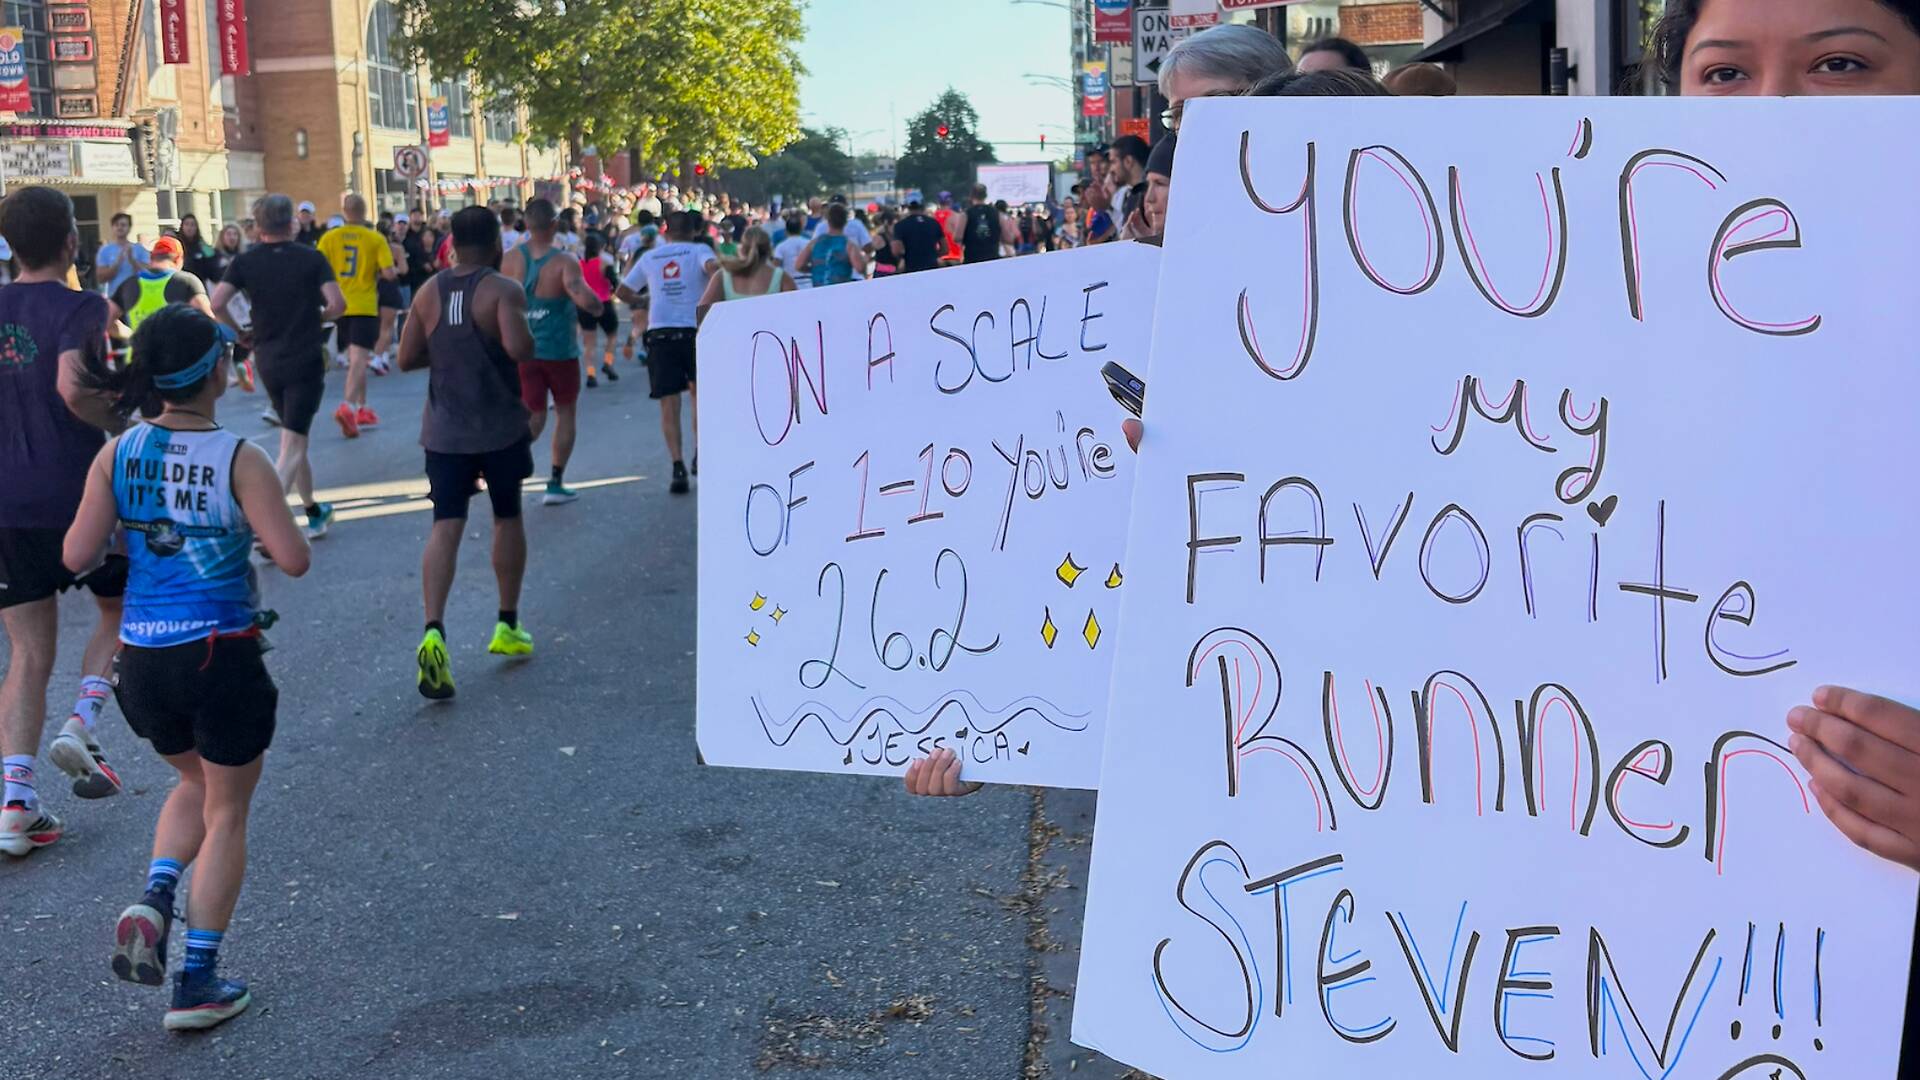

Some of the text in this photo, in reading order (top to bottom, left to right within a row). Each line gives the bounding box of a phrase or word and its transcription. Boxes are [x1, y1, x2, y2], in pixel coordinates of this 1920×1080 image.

[1142, 15, 1178, 32] ON
[340, 245, 359, 278] 3
[751, 281, 1109, 446] ON A SCALE
[126, 457, 215, 488] MULDER
[128, 484, 208, 512] IT'S ME
[745, 460, 815, 557] OF
[845, 442, 973, 543] 1-10
[799, 548, 1003, 690] 26.2
